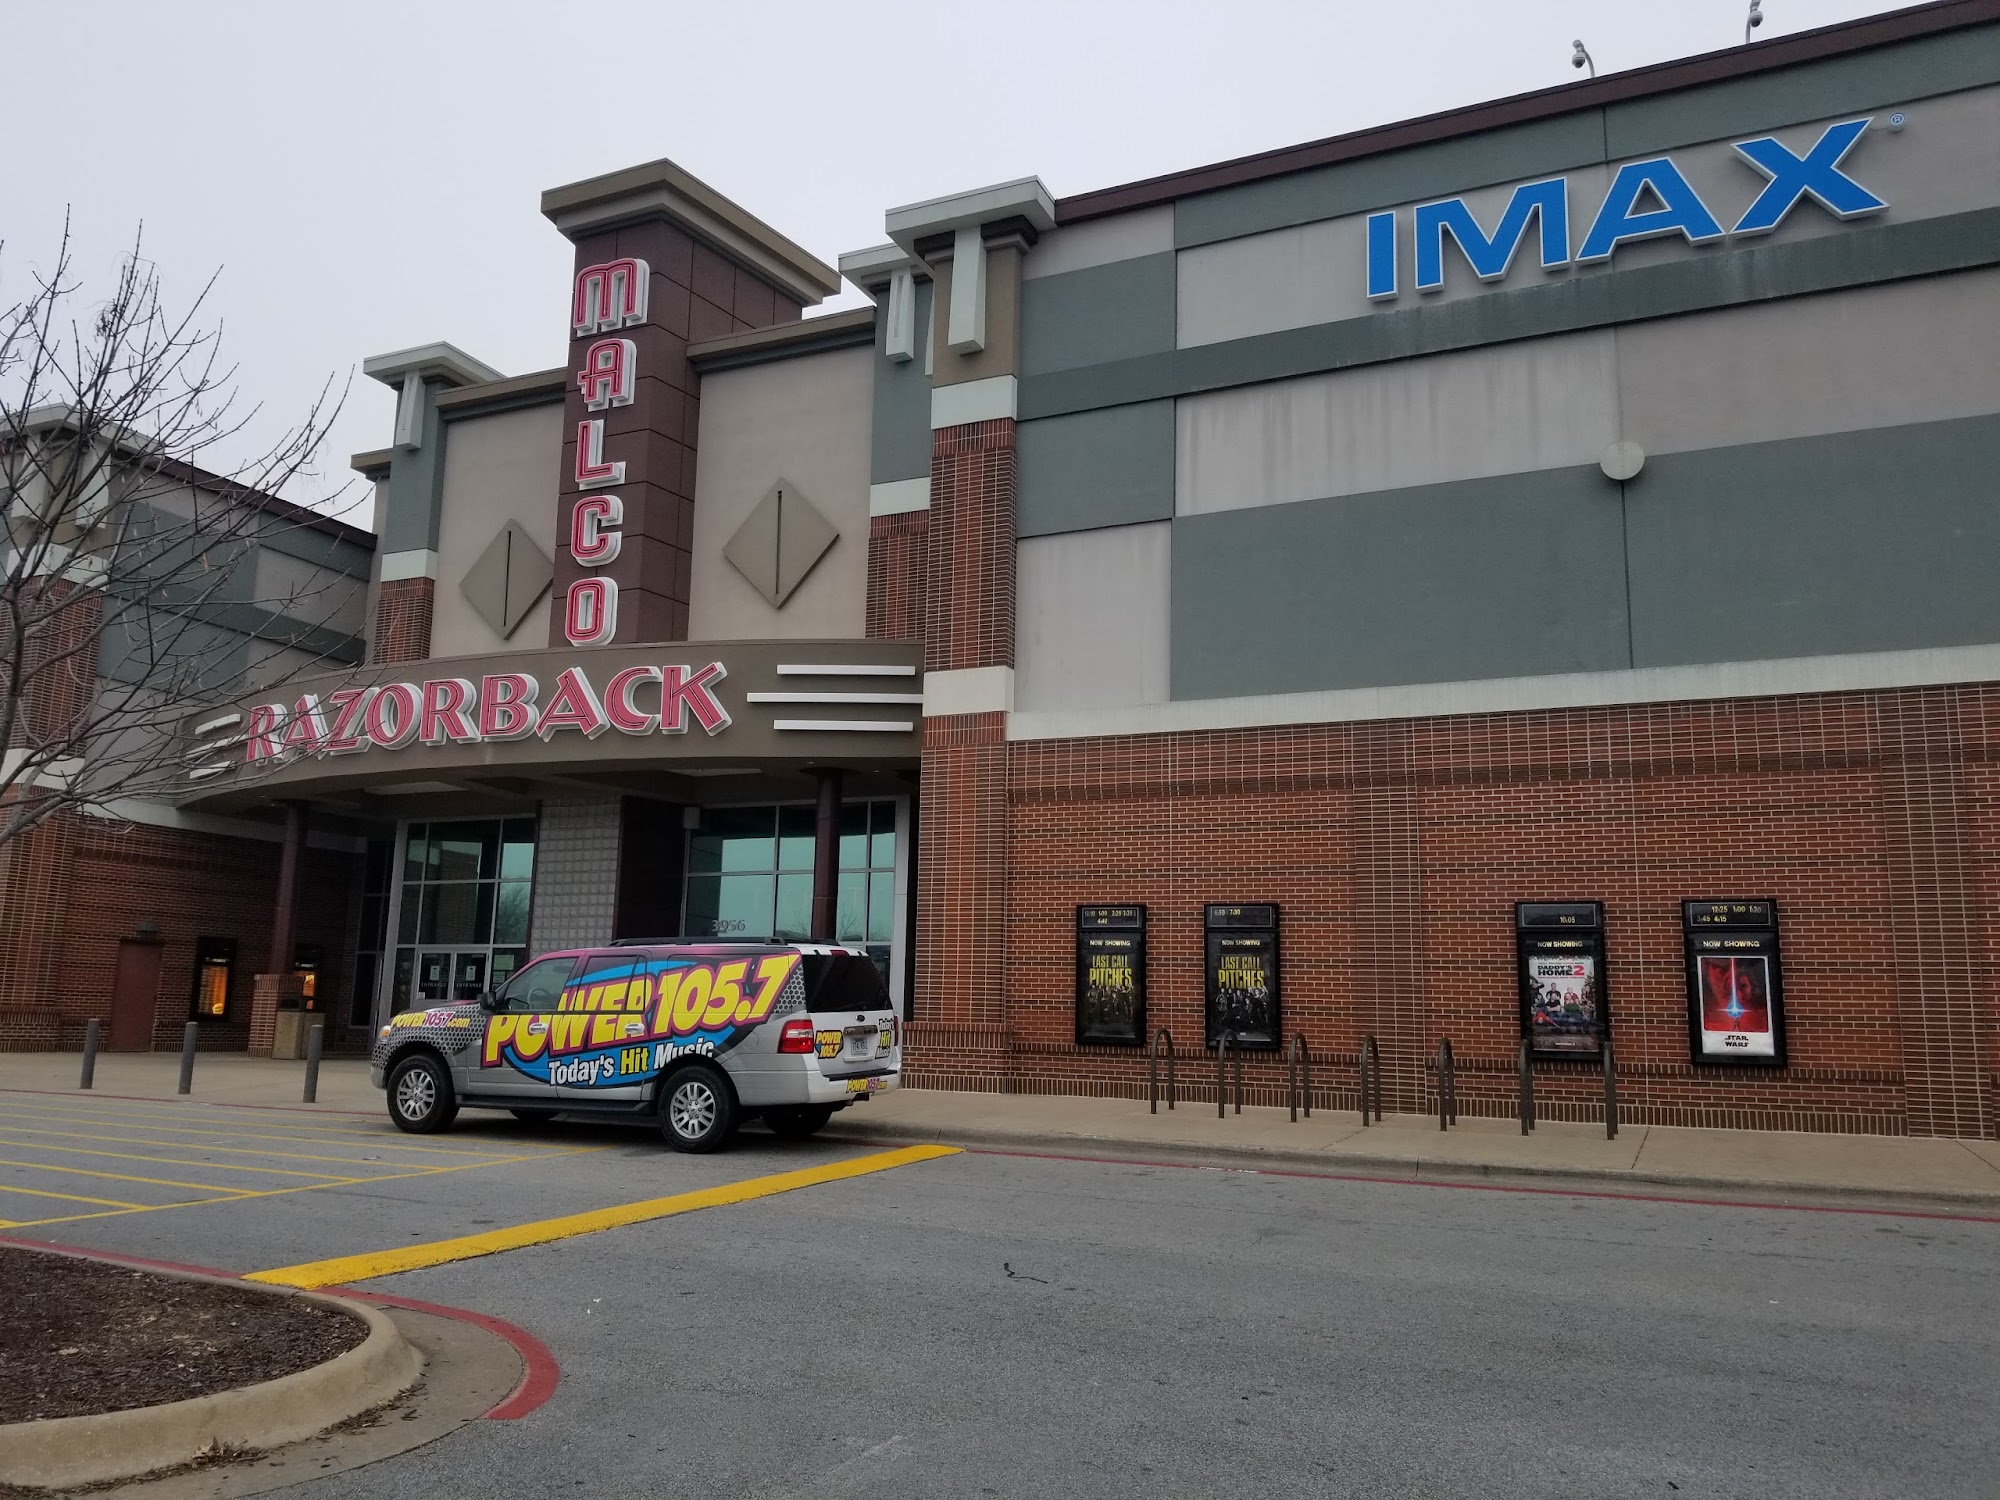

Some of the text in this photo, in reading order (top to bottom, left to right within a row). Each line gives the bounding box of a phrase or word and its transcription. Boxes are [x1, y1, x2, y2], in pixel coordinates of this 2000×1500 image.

[1366, 116, 1890, 302] IMAX
[566, 258, 650, 647] MALCO
[246, 661, 733, 764] RAZORBACK
[711, 919, 746, 932] 3956
[1702, 940, 1760, 948] NOW SHOWING
[1092, 954, 1129, 968] LAST CALL
[1220, 956, 1261, 970] LAST CALL
[1089, 968, 1133, 987] PITCHES
[1217, 970, 1265, 989] PITCHES
[1573, 965, 1585, 976] 2
[484, 953, 802, 1063] POWER 105.7
[815, 1030, 843, 1044] POWER
[879, 1030, 892, 1048] Hit
[818, 1043, 841, 1058] 105.7
[547, 1037, 715, 1086] Today's Hit Music
